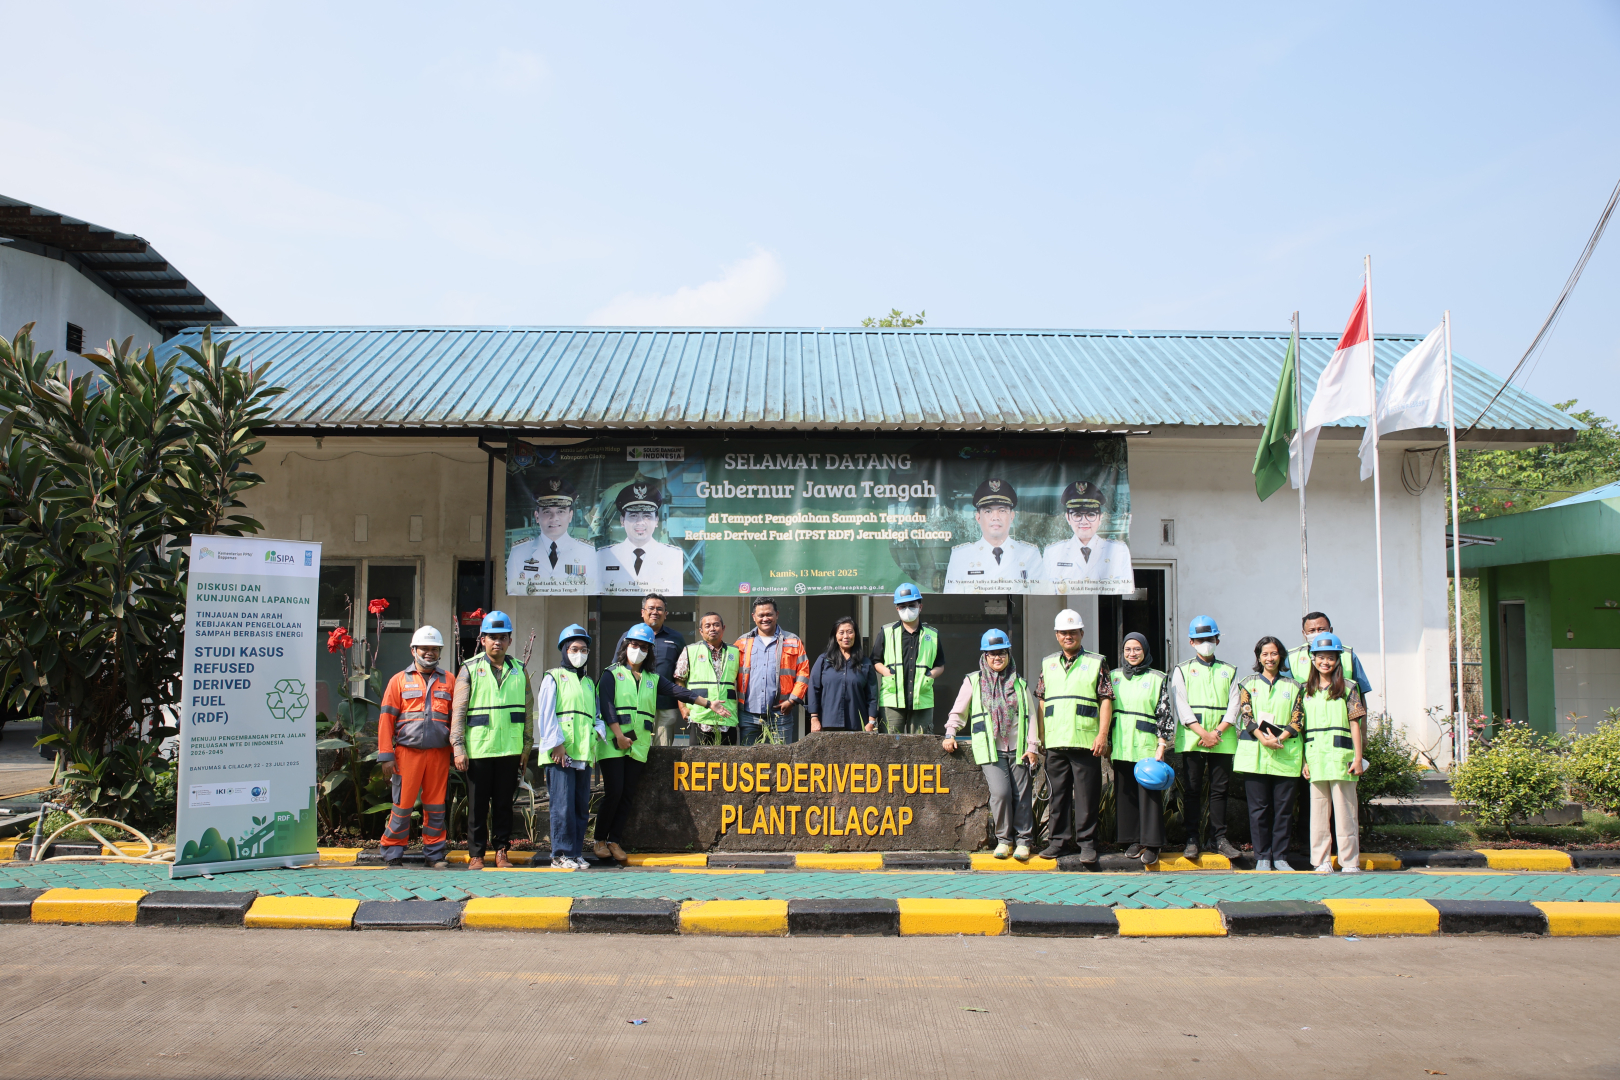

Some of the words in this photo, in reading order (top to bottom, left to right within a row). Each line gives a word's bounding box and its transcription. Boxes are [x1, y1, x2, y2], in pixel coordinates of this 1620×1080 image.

[725, 453, 820, 470] SELAMAT
[825, 454, 912, 470] DATANG
[696, 480, 794, 498] Gubernur
[802, 481, 857, 498] Jawa
[860, 480, 937, 502] Tengah
[708, 513, 719, 523] di
[721, 513, 763, 526] Tempat
[765, 512, 830, 526] Pengolahan
[832, 512, 878, 525] Sampah
[879, 512, 926, 525] Terpadu
[685, 530, 722, 540] Refuse
[724, 530, 767, 540] Derived
[769, 530, 793, 540] Fuel
[794, 529, 826, 542] (TPST
[828, 529, 854, 541] RDF)
[856, 529, 909, 542] Jeruklegi
[910, 529, 952, 542] Cilacap
[277, 555, 294, 563] SIPA
[770, 570, 798, 578] Kamis,
[837, 569, 858, 577] 2025
[197, 583, 237, 591] DISKUSI
[196, 594, 258, 603] KUNJUNGAN
[262, 596, 310, 605] LAPANGAN
[194, 647, 235, 657] STUDI
[240, 647, 284, 657] KASUS
[194, 663, 254, 674] REFUSED
[193, 679, 251, 690] DERIVED
[192, 696, 225, 706] FUEL
[192, 711, 229, 725] (RDF)
[673, 761, 770, 792] REFUSE
[776, 762, 882, 794] DERIVED
[888, 763, 950, 794] FUEL
[721, 804, 801, 835] PLANT
[804, 805, 914, 836] CILACAP
